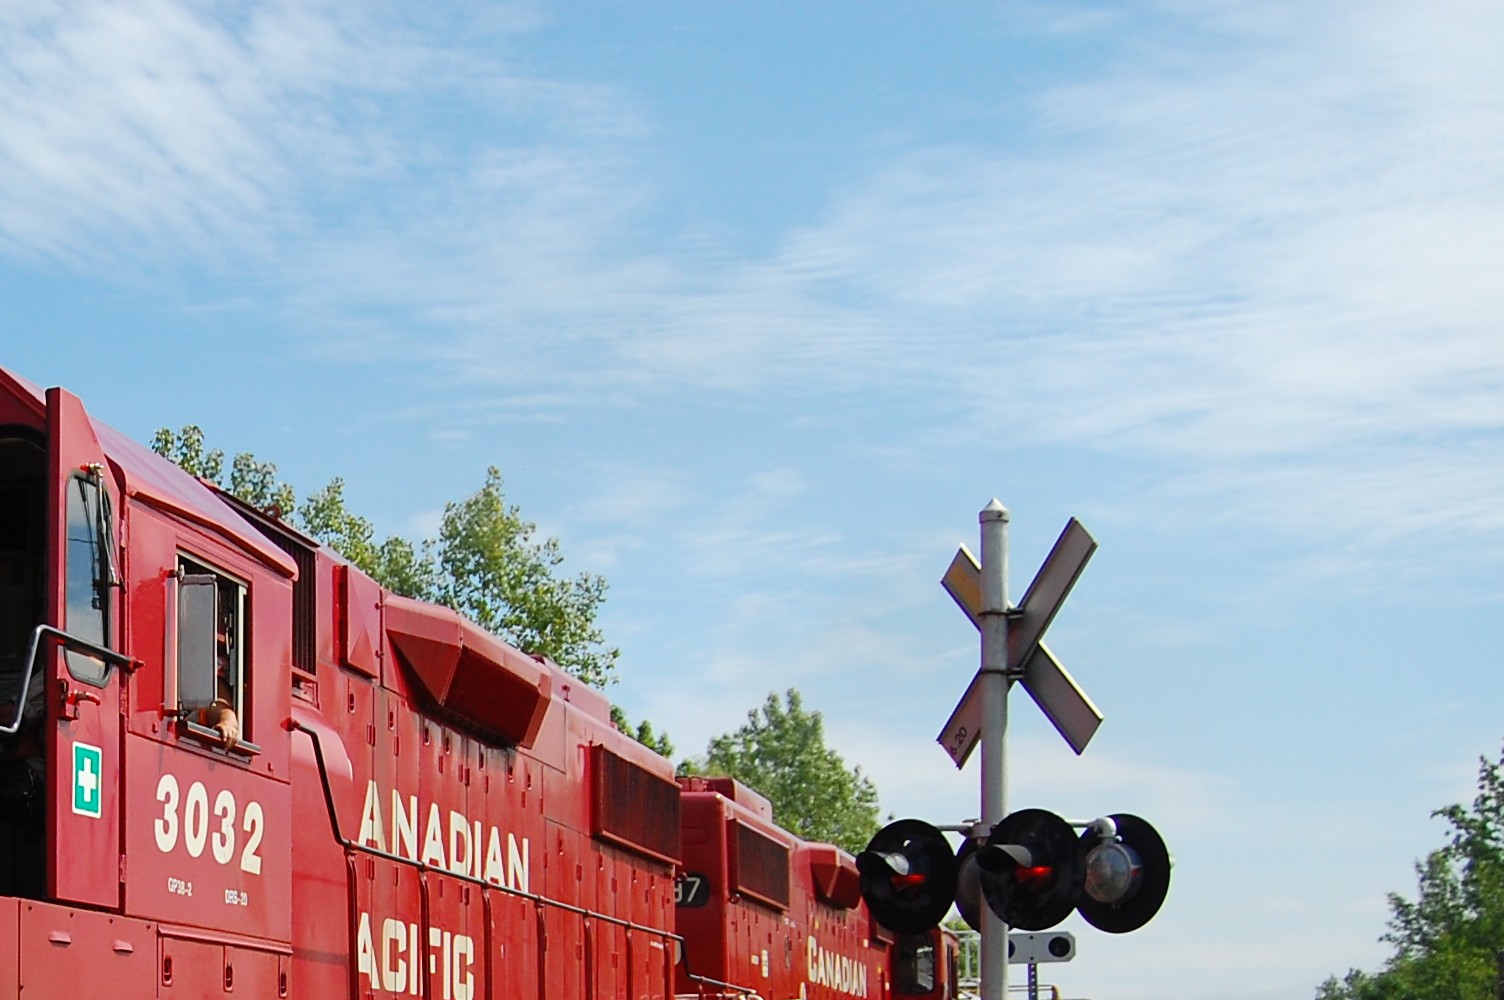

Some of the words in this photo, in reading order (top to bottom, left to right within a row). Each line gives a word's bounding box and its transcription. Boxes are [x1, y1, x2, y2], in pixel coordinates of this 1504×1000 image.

[154, 773, 265, 875] 3032
[357, 779, 530, 900] ANADIAN
[807, 935, 868, 1000] CANADIAN
